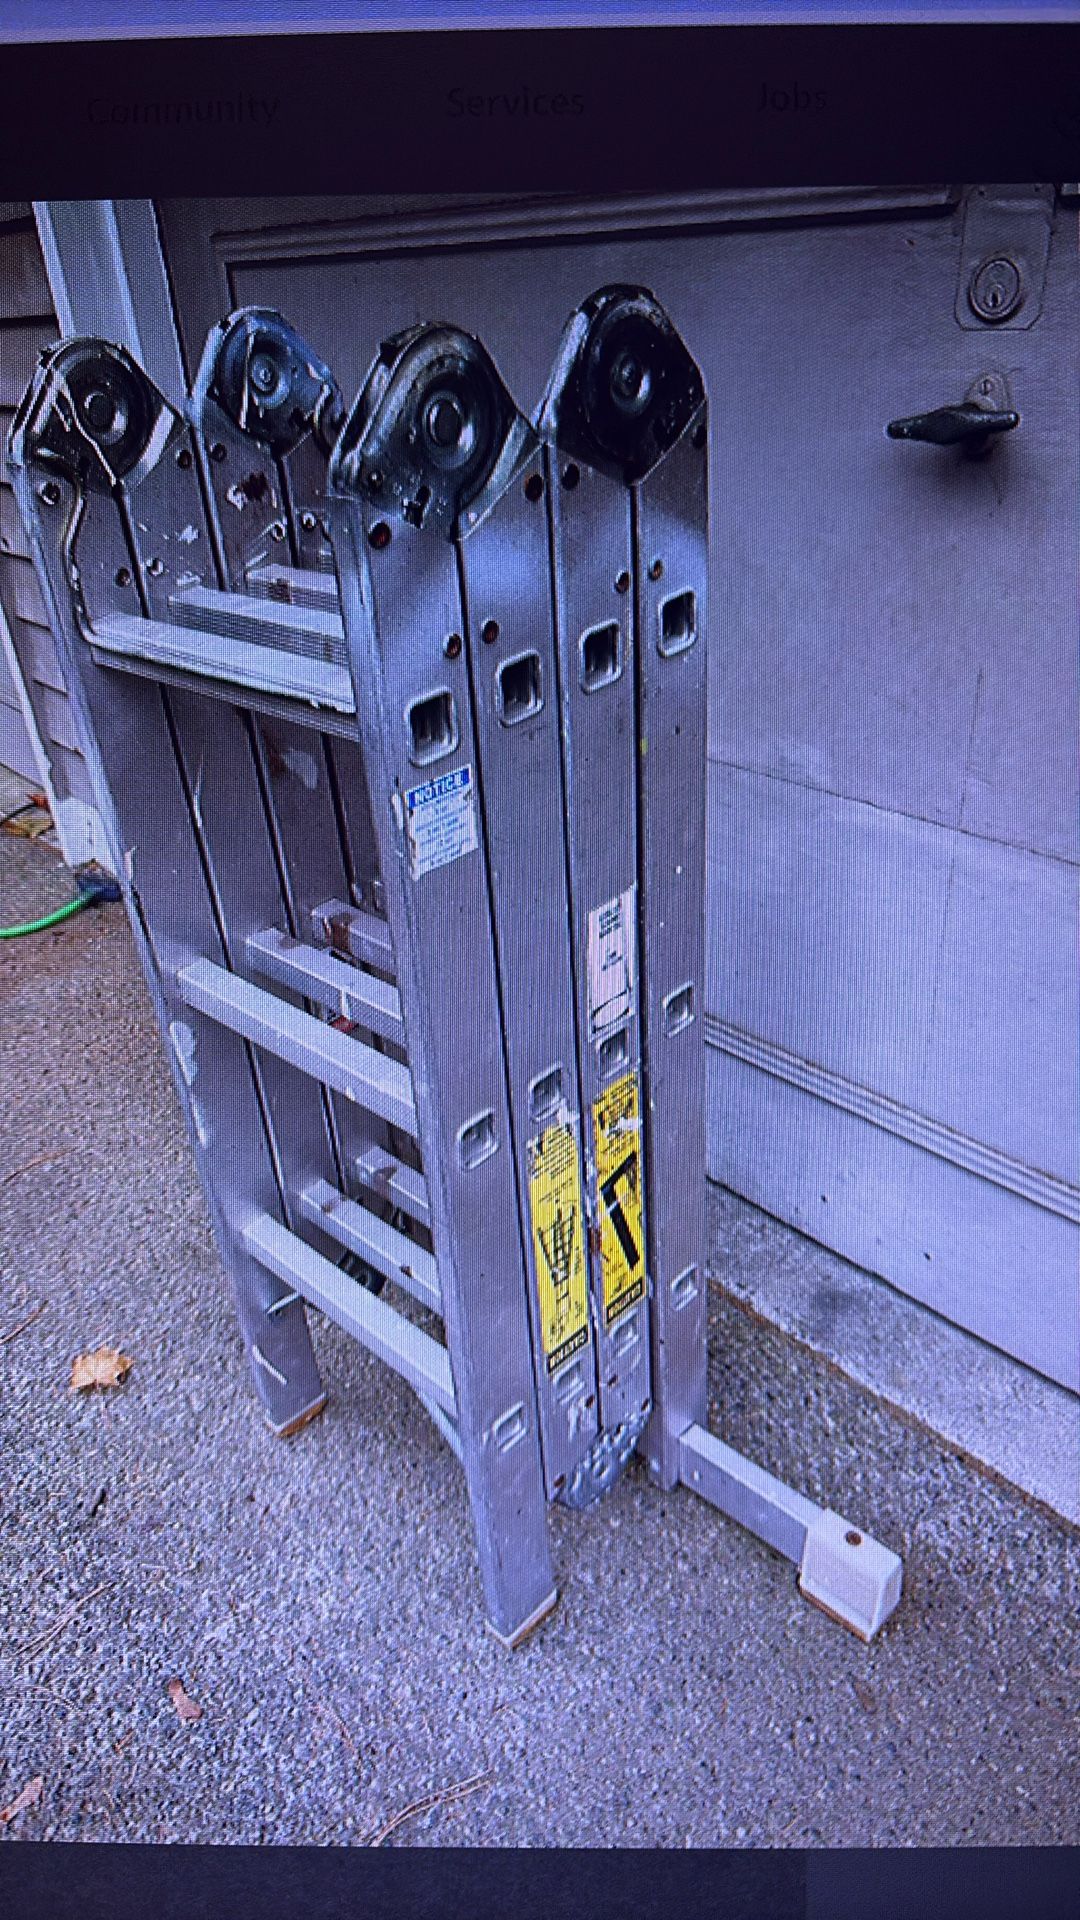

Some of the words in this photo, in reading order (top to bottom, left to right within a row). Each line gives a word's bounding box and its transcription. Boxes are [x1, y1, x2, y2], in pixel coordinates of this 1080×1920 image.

[86, 92, 281, 128] Community
[446, 84, 585, 118] Services
[756, 80, 828, 113] Jobs
[413, 768, 464, 807] NOTICE
